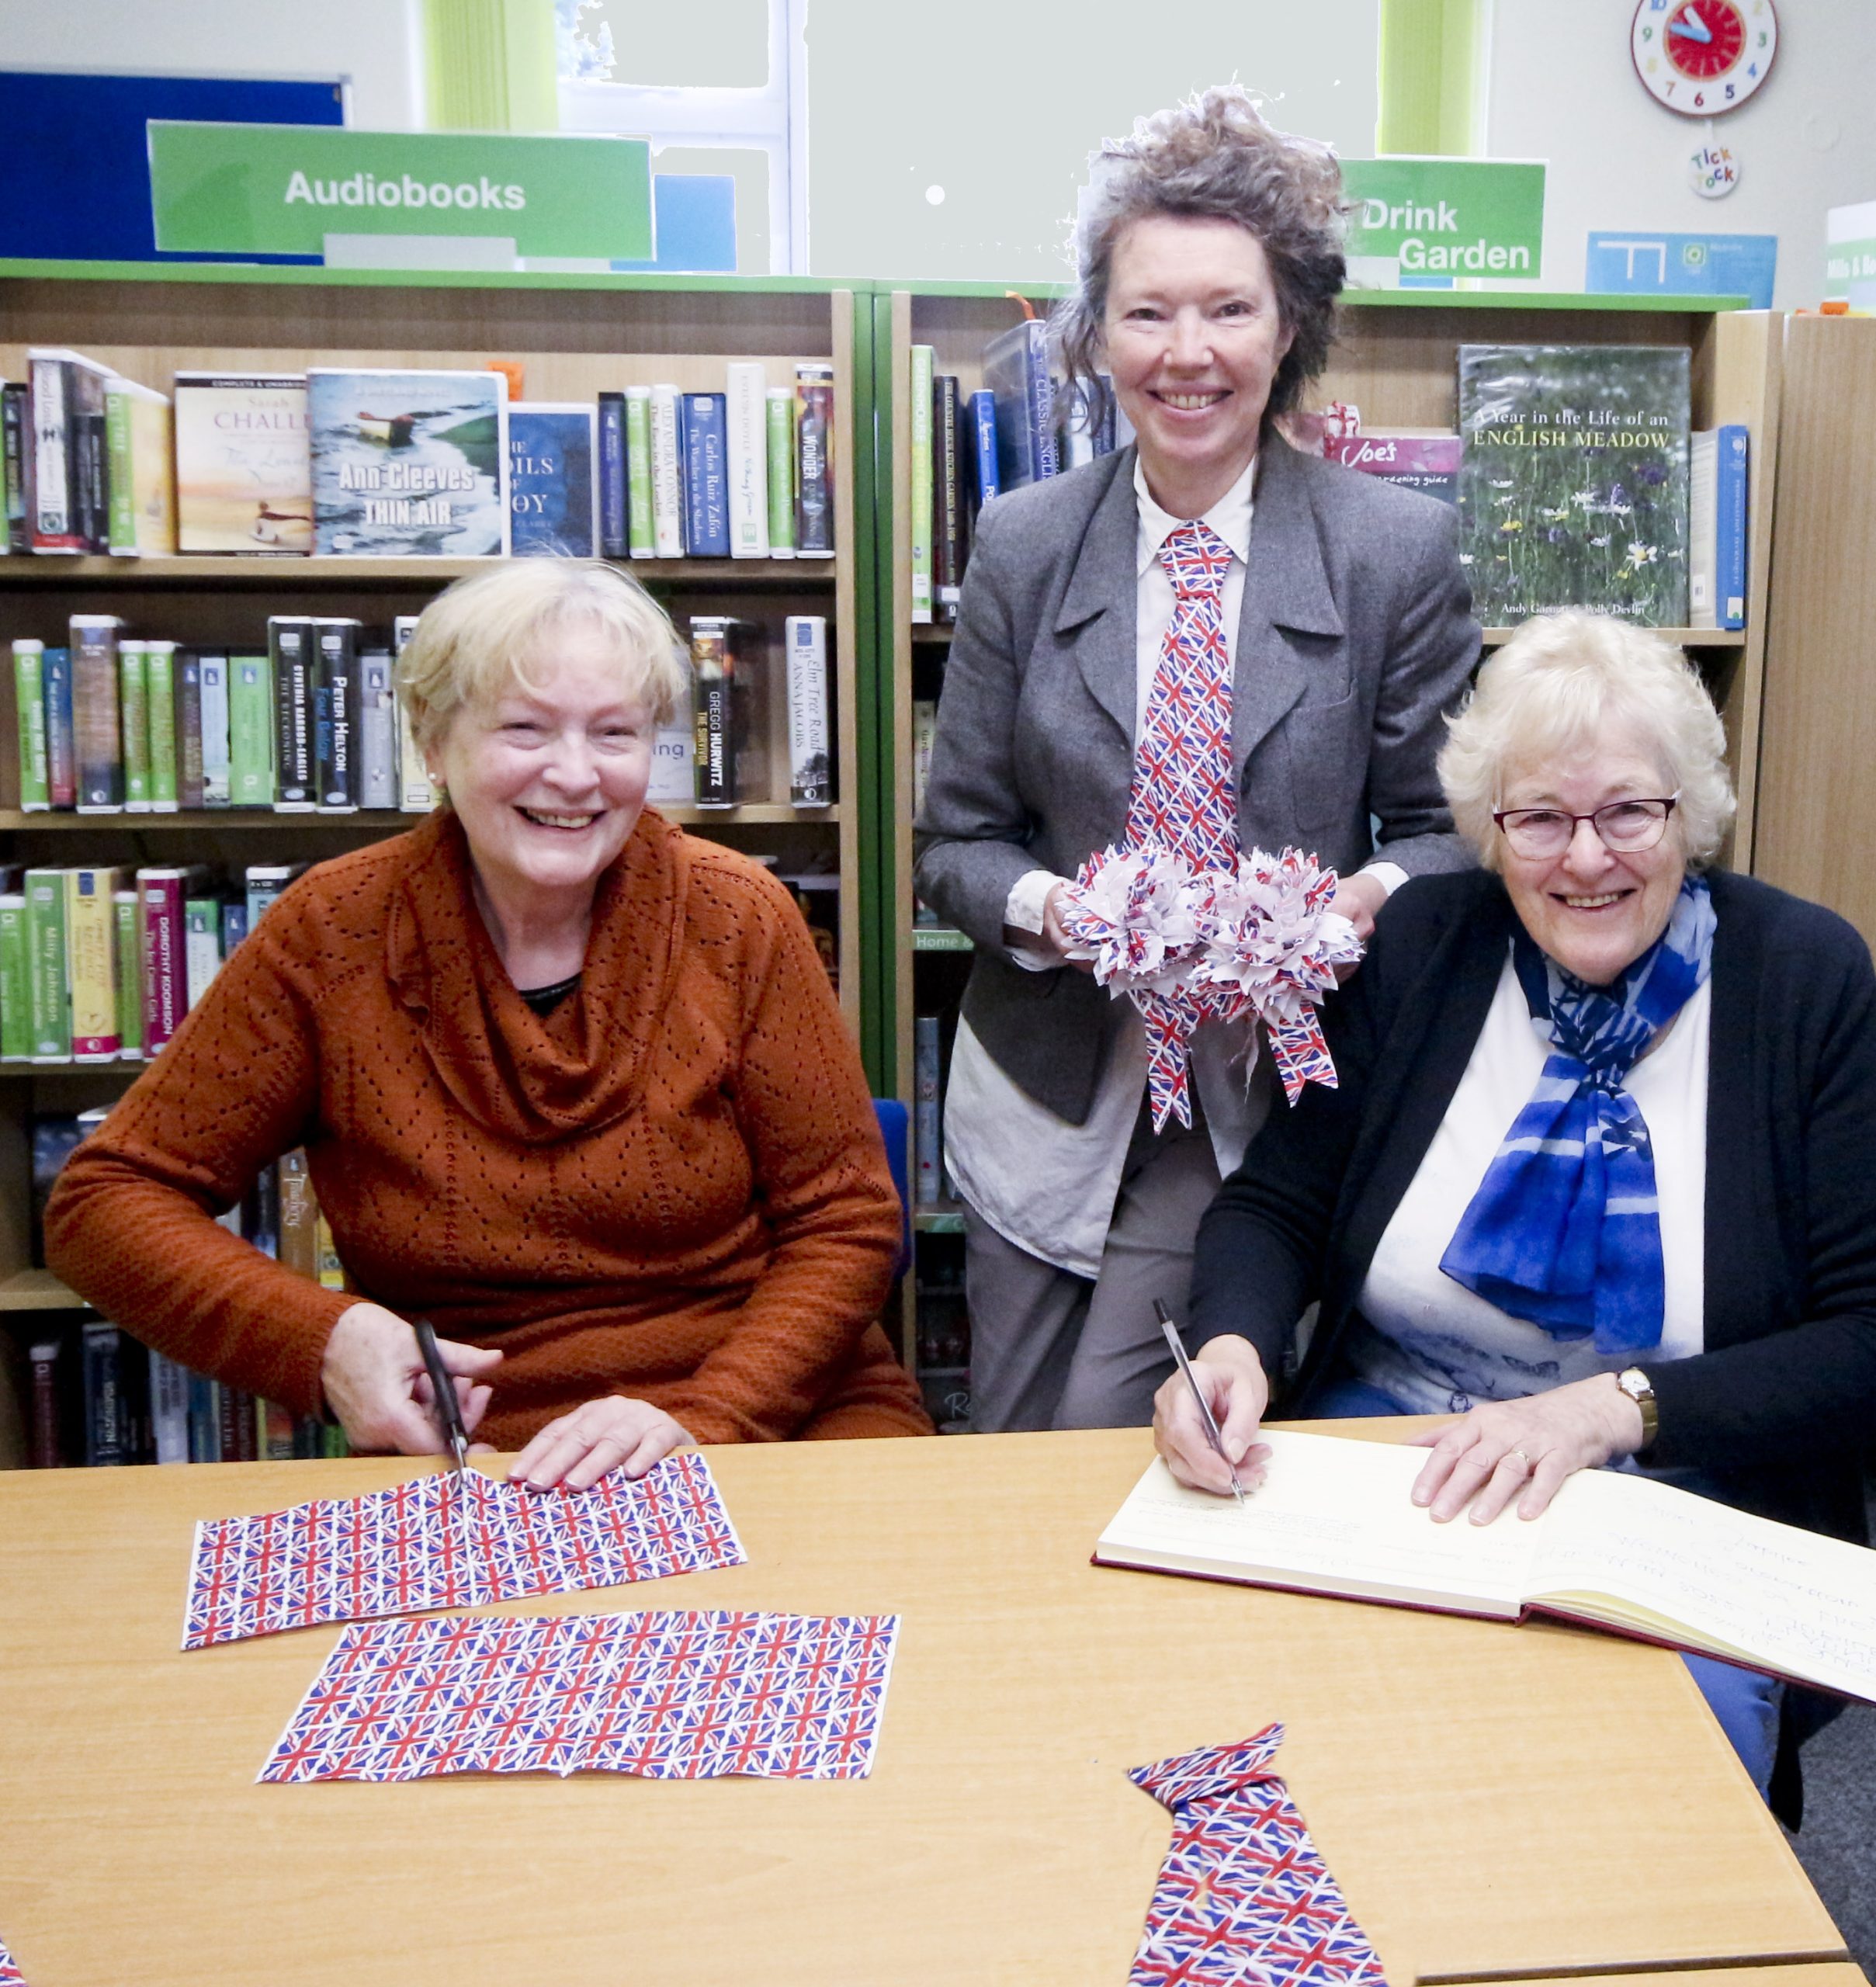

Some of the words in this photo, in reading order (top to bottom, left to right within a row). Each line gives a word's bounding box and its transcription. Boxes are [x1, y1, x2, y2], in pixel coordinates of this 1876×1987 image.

[1642, 26, 1653, 43] 9
[1758, 31, 1767, 48] 3
[1646, 57, 1659, 73] 8
[1746, 62, 1757, 78] 4
[1666, 80, 1676, 97] 7
[1694, 92, 1704, 107] 6
[1725, 83, 1735, 99] 5
[284, 171, 526, 211] Audiobooks
[1361, 198, 1458, 232] Drink
[1399, 238, 1530, 271] Garden
[915, 357, 927, 442] GREENHOUSE
[1036, 379, 1049, 431] CLASSIC
[1490, 410, 1527, 425] Year
[1532, 410, 1548, 425] in
[1555, 410, 1581, 425] the
[1589, 410, 1620, 426] Life
[1627, 410, 1644, 426] of
[1649, 414, 1669, 426] an
[690, 428, 700, 443] The
[1474, 430, 1566, 446] ENGLISH
[1575, 432, 1670, 449] MEADOW
[509, 457, 553, 475] ILS
[691, 447, 701, 480] Watcher
[705, 434, 719, 472] Carlos
[802, 435, 818, 480] WONDER
[1341, 440, 1398, 468] Joe's
[338, 463, 381, 491] Ann
[387, 463, 475, 491] Cleeves
[706, 475, 720, 501] Ruiz
[1374, 474, 1420, 487] rdening
[1422, 474, 1448, 487] guide
[665, 469, 677, 518] CONNOR
[692, 494, 702, 506] the
[364, 499, 411, 525] THIN
[416, 500, 453, 525] AIR
[693, 509, 703, 546] Shadows
[707, 505, 721, 538] Zafón
[1501, 602, 1528, 616] Andy
[1611, 602, 1645, 616] Devlin
[280, 677, 290, 696] THE
[293, 664, 304, 705] CYNTHIA
[792, 663, 804, 701] ANNA
[806, 660, 824, 684] Elm
[316, 688, 330, 717] Four
[332, 676, 348, 719] PETER
[709, 692, 721, 730] GREGG
[807, 688, 821, 714] Tree
[697, 712, 708, 726] THE
[792, 702, 806, 748] JACOBS
[809, 719, 825, 751] Road
[281, 703, 292, 771] RECKONING
[317, 721, 331, 761] Below
[335, 722, 349, 772] HELTON
[697, 728, 709, 766] SURVIVOR
[710, 733, 723, 786] HURWITZ
[44, 927, 57, 959] Milly
[158, 917, 172, 973] DOROTHY
[916, 935, 959, 948] Home
[47, 964, 58, 1022] Johnson
[161, 976, 174, 1035] KOOMSON
